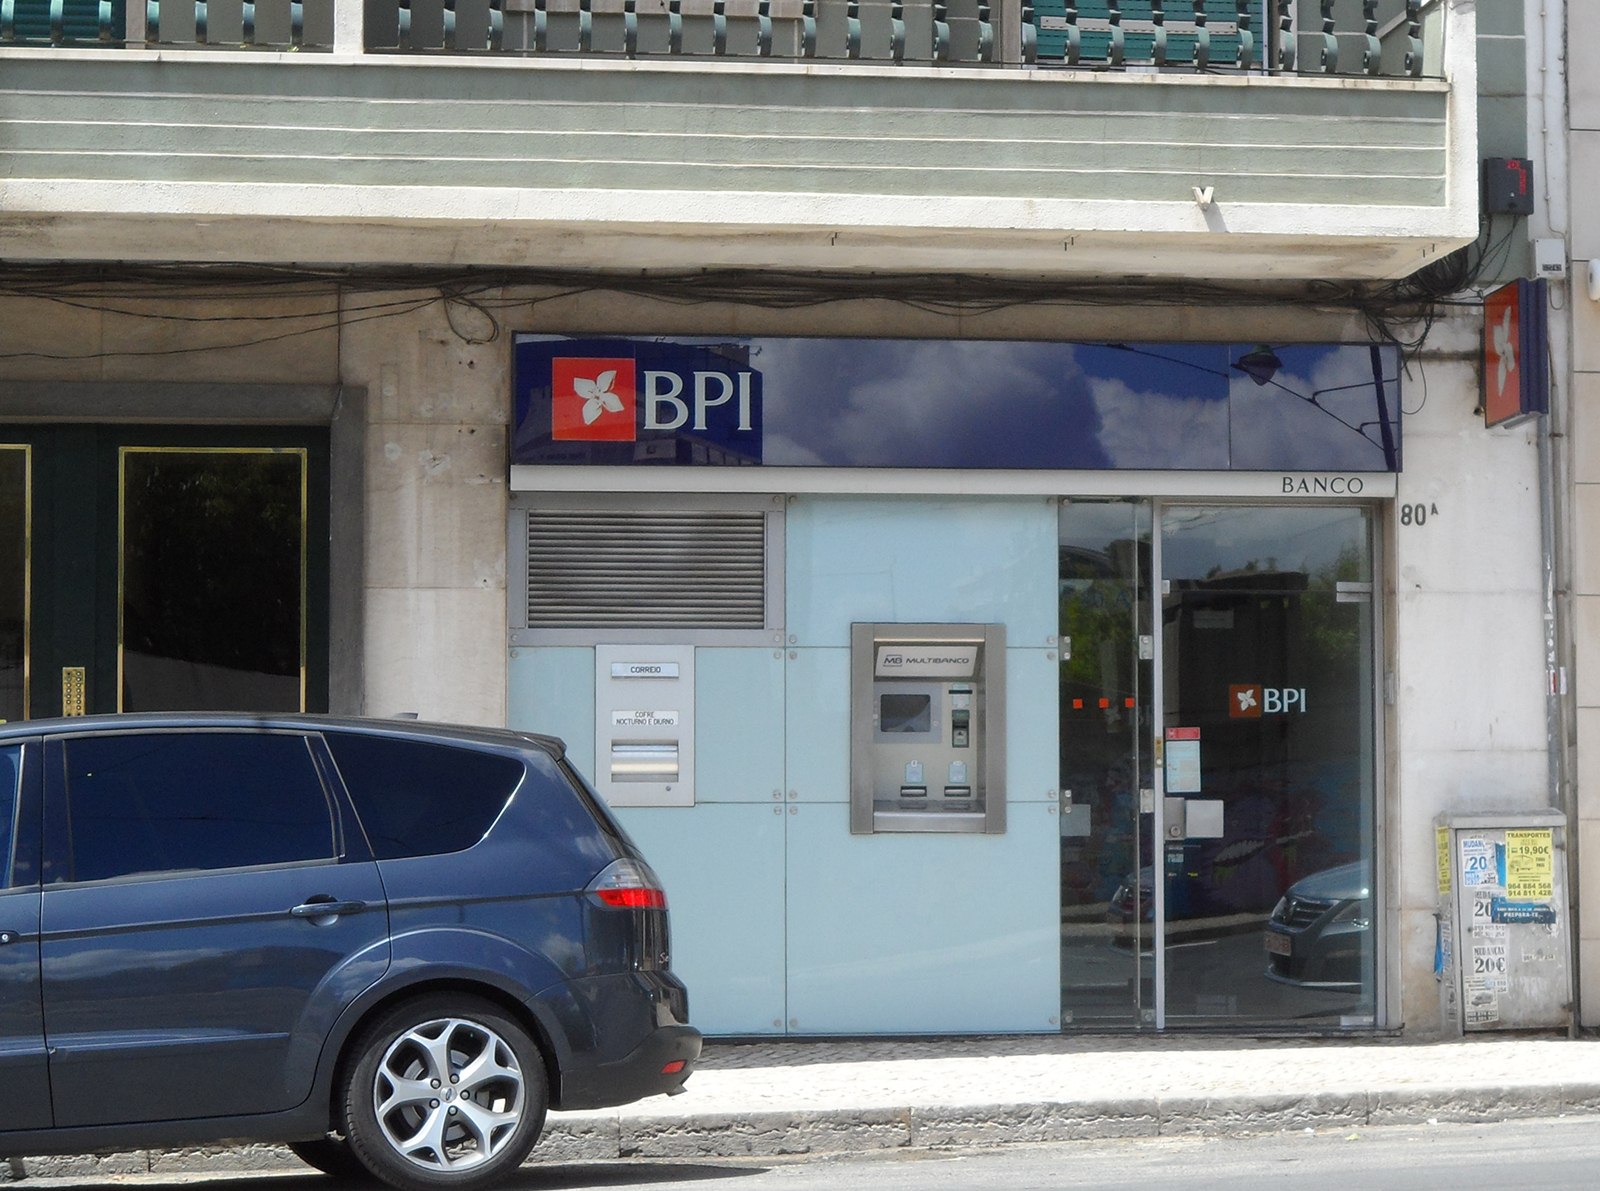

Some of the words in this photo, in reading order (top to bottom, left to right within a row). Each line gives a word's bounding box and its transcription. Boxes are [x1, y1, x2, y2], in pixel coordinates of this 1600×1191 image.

[643, 370, 753, 431] BPI
[1282, 476, 1364, 494] BANCO
[905, 656, 970, 664] MULTIBANCO
[630, 666, 661, 674] CORREIO
[1263, 688, 1307, 713] BPI
[1474, 957, 1506, 973] 20€
